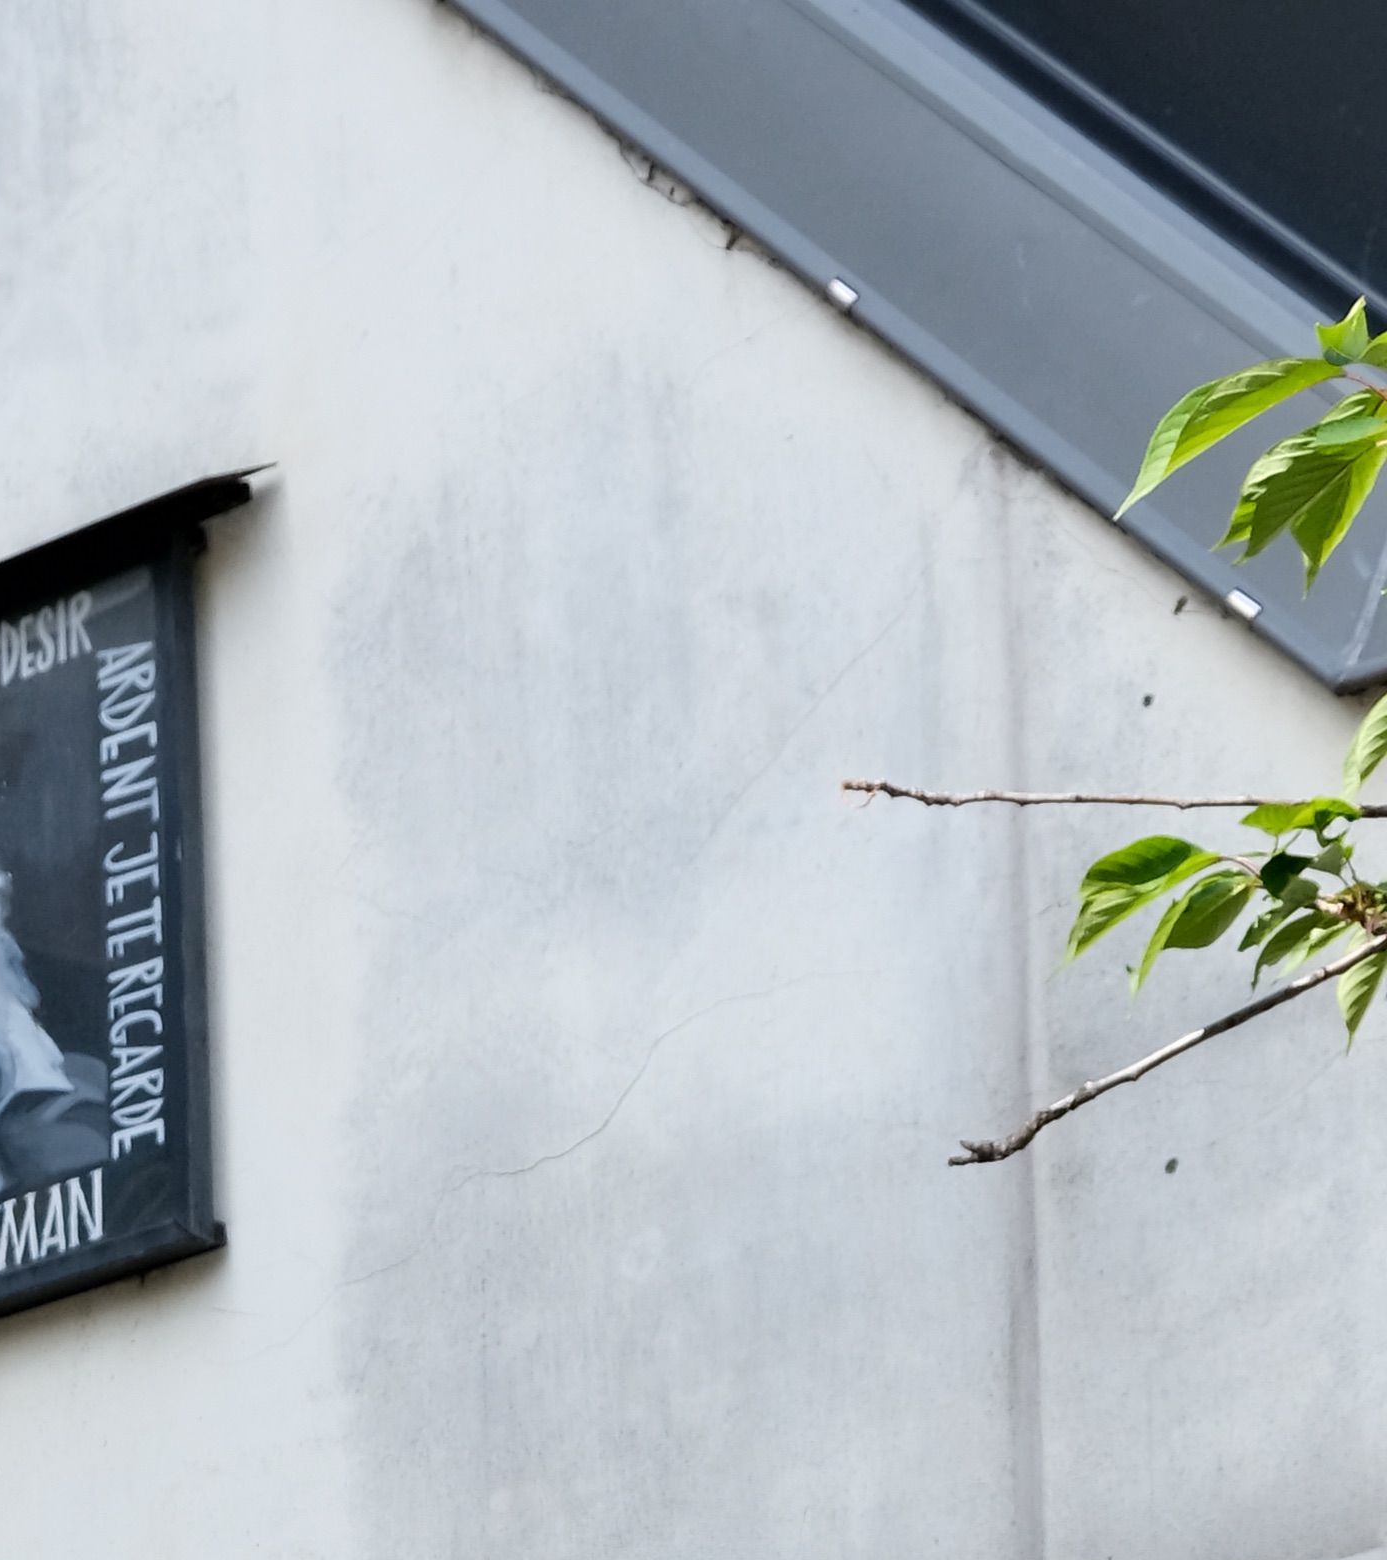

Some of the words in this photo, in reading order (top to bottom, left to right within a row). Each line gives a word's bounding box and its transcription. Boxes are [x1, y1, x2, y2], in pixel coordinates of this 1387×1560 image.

[95, 641, 161, 823] ARDENT
[103, 833, 161, 905] JE
[105, 898, 162, 959] TE
[105, 957, 164, 1160] REGARDE
